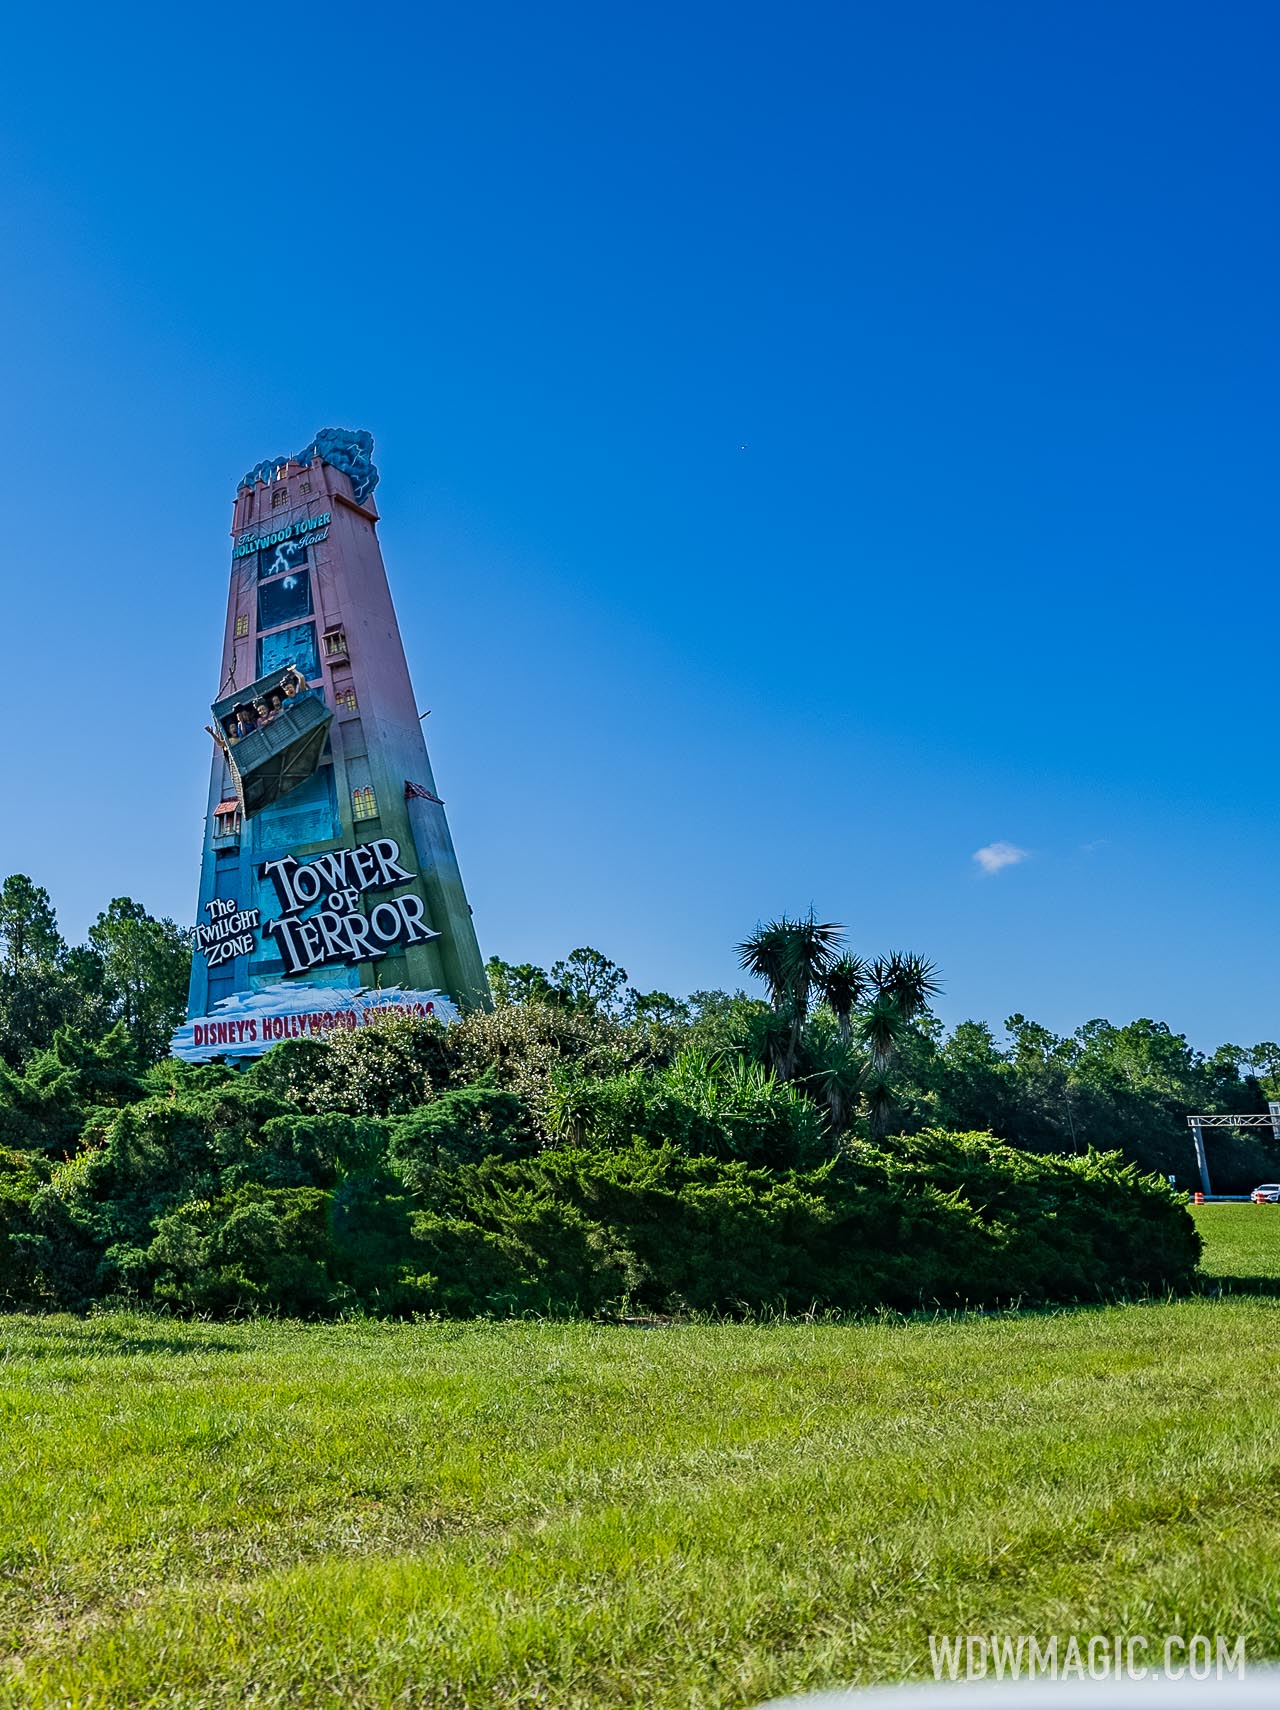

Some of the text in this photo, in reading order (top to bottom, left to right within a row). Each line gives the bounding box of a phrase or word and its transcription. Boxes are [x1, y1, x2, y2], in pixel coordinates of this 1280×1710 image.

[232, 512, 331, 559] HOLLYWOOD TOWER
[238, 533, 255, 545] The
[298, 527, 329, 549] Hotel
[264, 838, 418, 913] TOWER
[205, 898, 236, 919] The
[327, 884, 360, 914] OF
[189, 909, 259, 951] TWILIGHT
[268, 894, 442, 973] TERROR
[203, 933, 254, 967] ZONE
[193, 1018, 257, 1046] DISNEY'S
[262, 1009, 357, 1040] HOLLYWOOD
